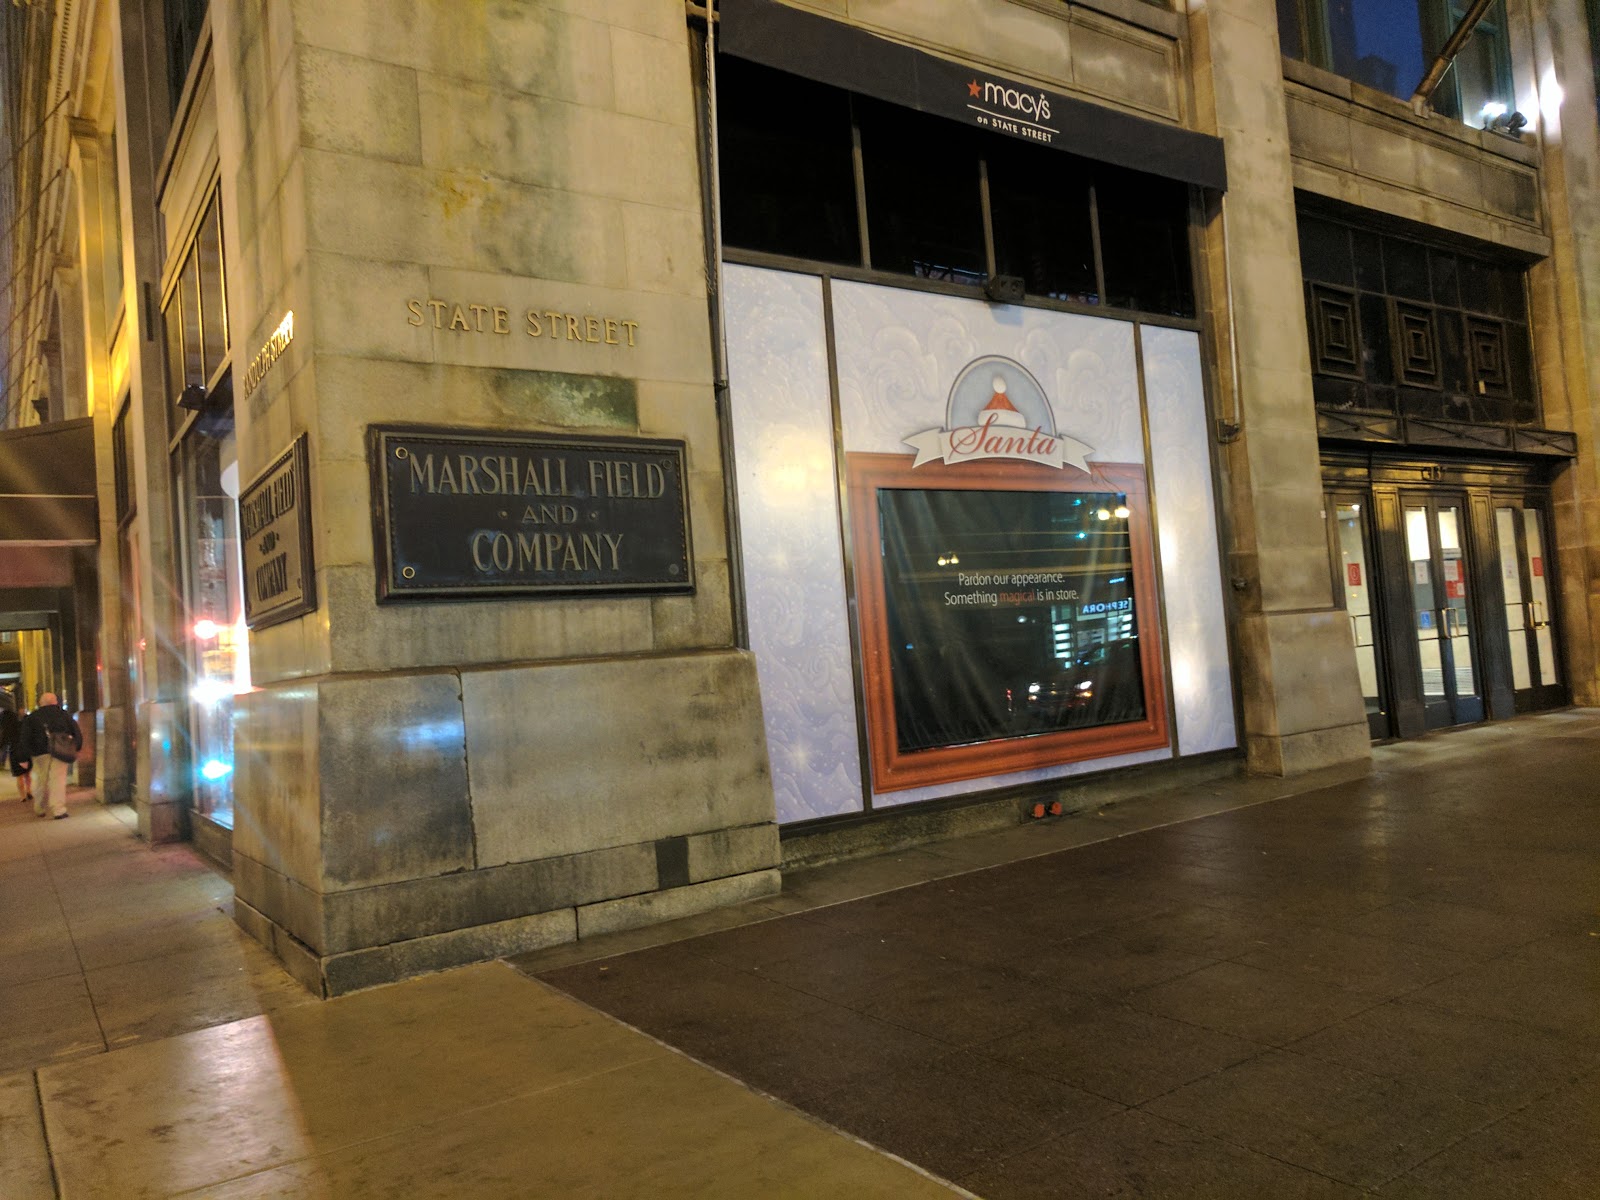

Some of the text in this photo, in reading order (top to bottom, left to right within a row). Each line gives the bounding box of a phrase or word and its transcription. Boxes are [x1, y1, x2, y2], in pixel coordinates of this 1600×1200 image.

[977, 116, 1052, 142] on STATE STREET
[270, 310, 294, 362] STREET
[407, 299, 639, 347] STATE STREET
[949, 412, 1057, 459] Santa
[409, 453, 665, 499] MARSHALL FIELD
[521, 505, 577, 524] AND
[472, 532, 624, 572] COMPANY
[944, 588, 1079, 606] Something magical is in store.
[958, 572, 1065, 587] Pardon our appearance.
